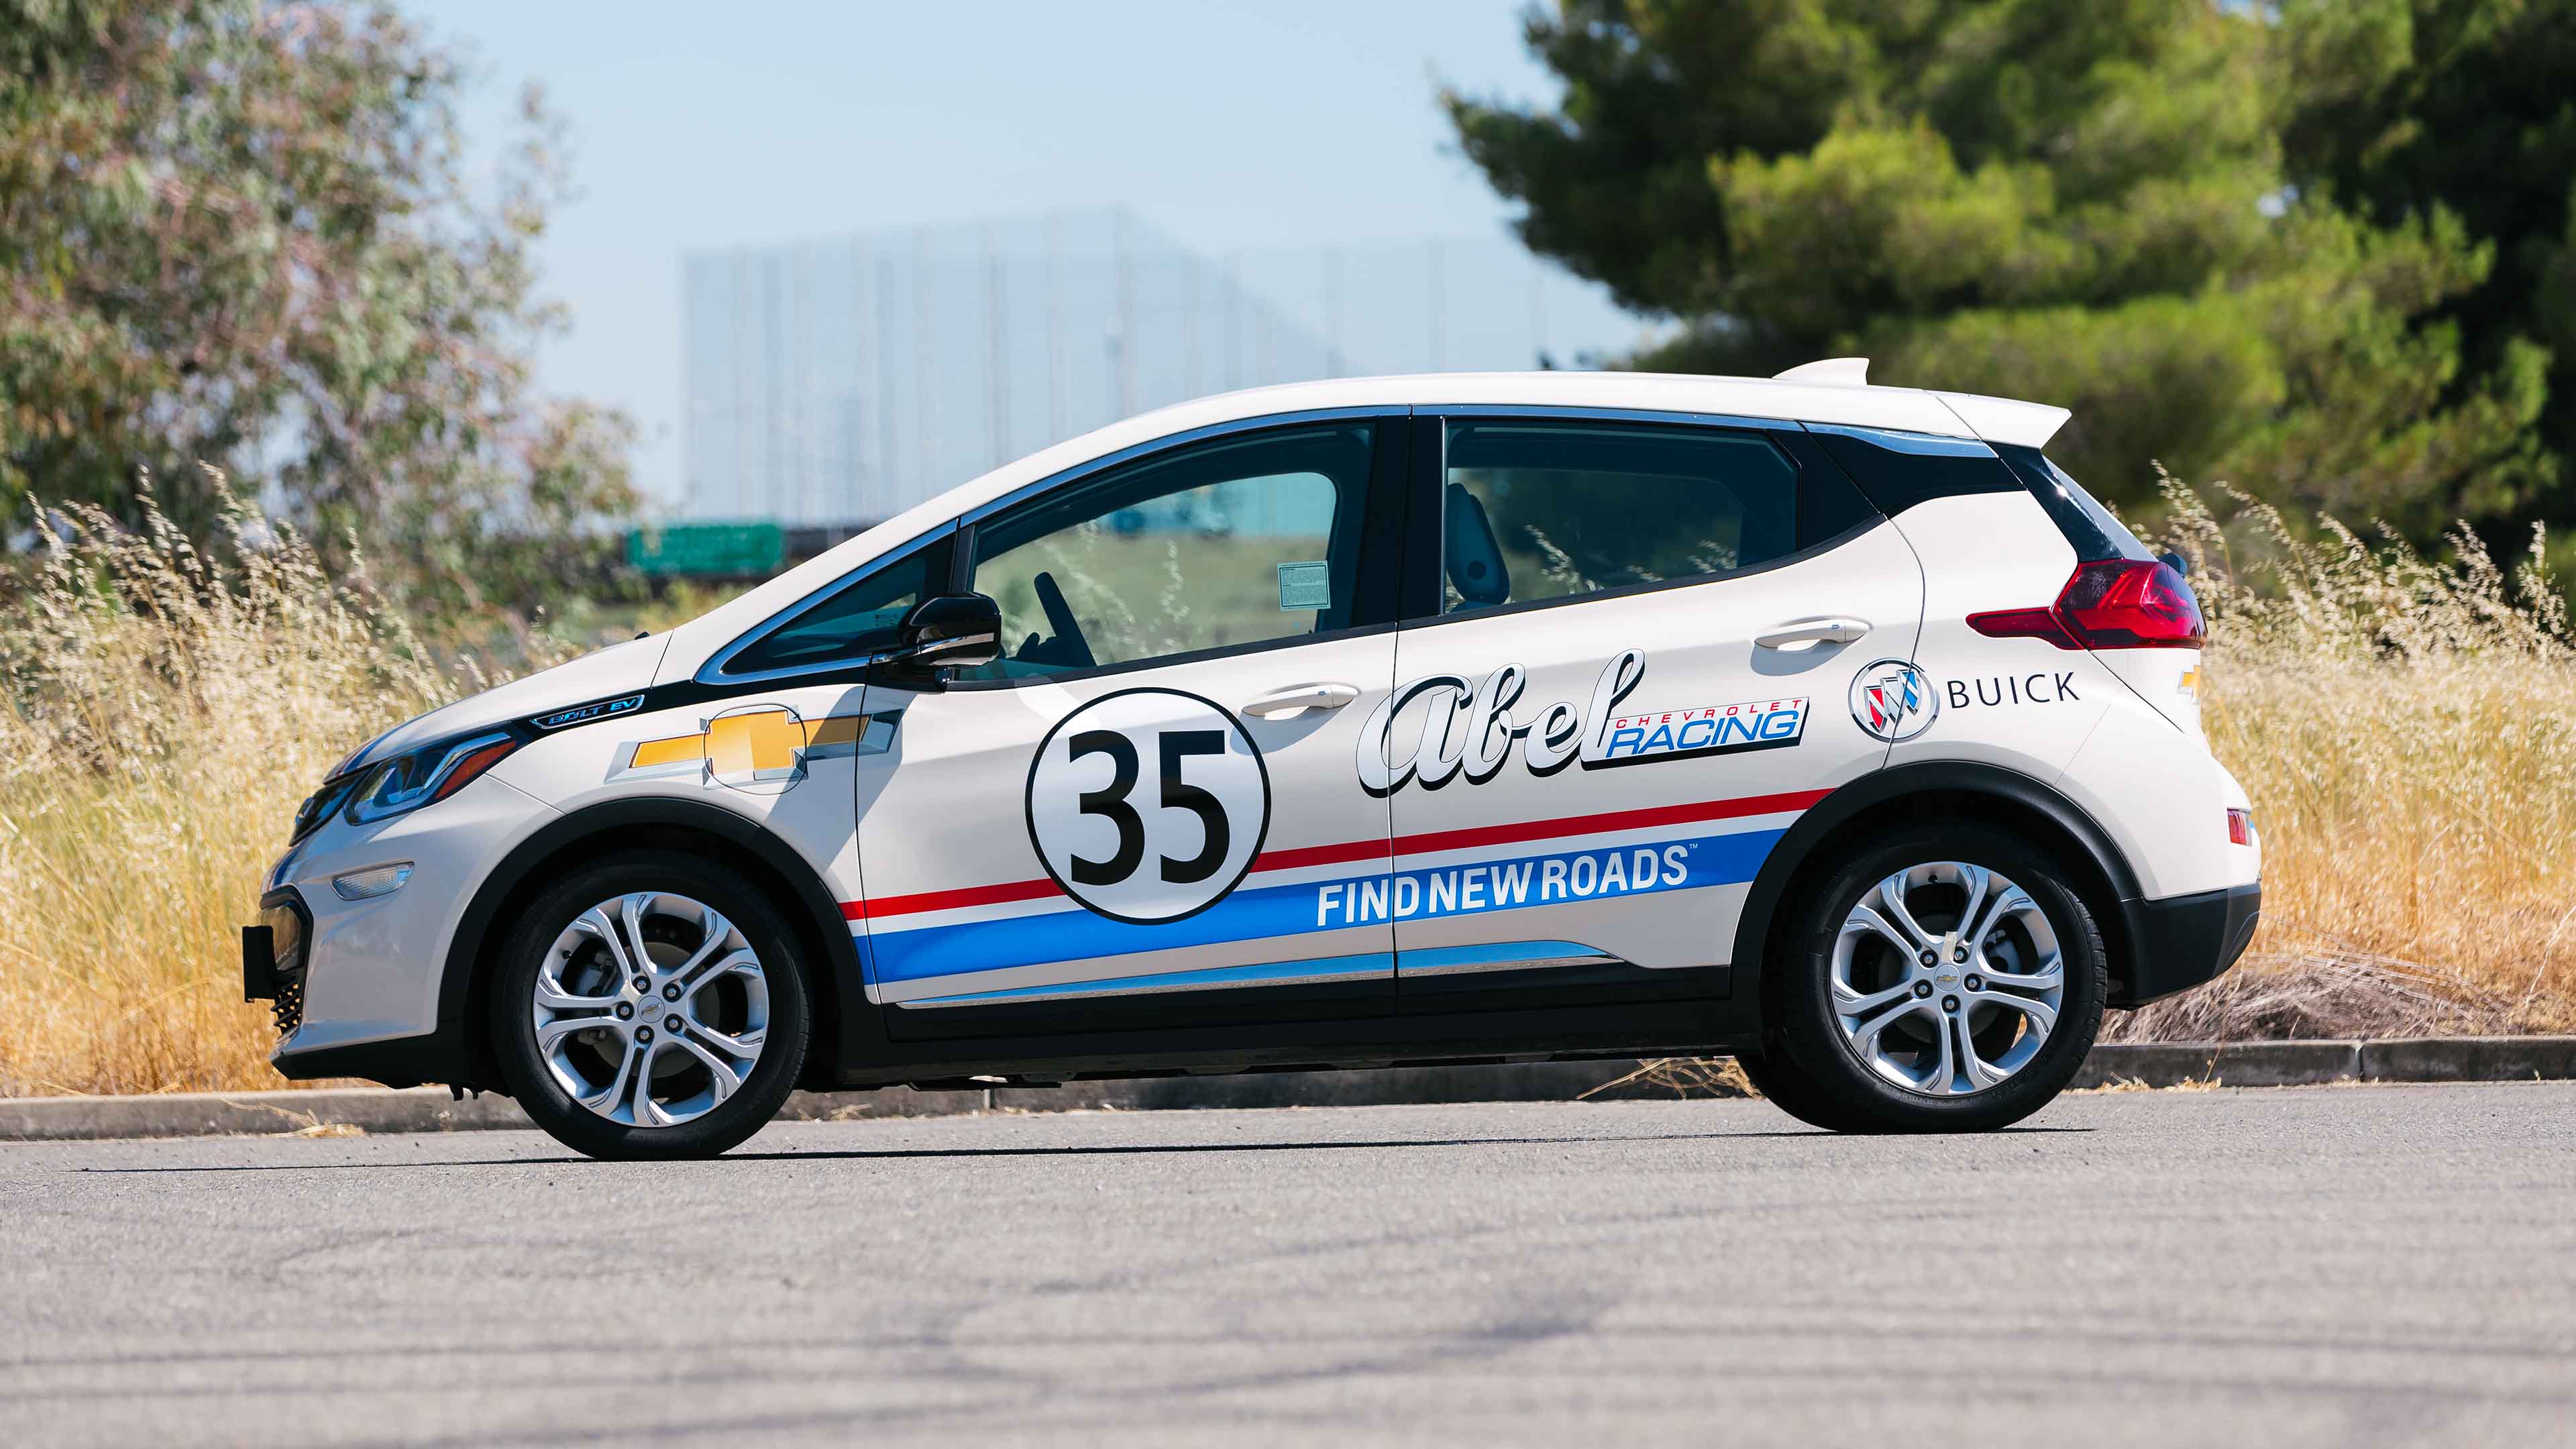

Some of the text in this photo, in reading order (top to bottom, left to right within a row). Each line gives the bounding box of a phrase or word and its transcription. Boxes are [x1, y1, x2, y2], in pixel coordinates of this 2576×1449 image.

[548, 698, 637, 724] BOLT EV
[1947, 672, 2080, 709] BUICK
[1606, 710, 1799, 758] RACING
[1615, 699, 1803, 729] CHEVROLET
[1069, 729, 1230, 885] 35
[1317, 877, 1420, 927] FIND
[1429, 861, 1539, 914] NEW
